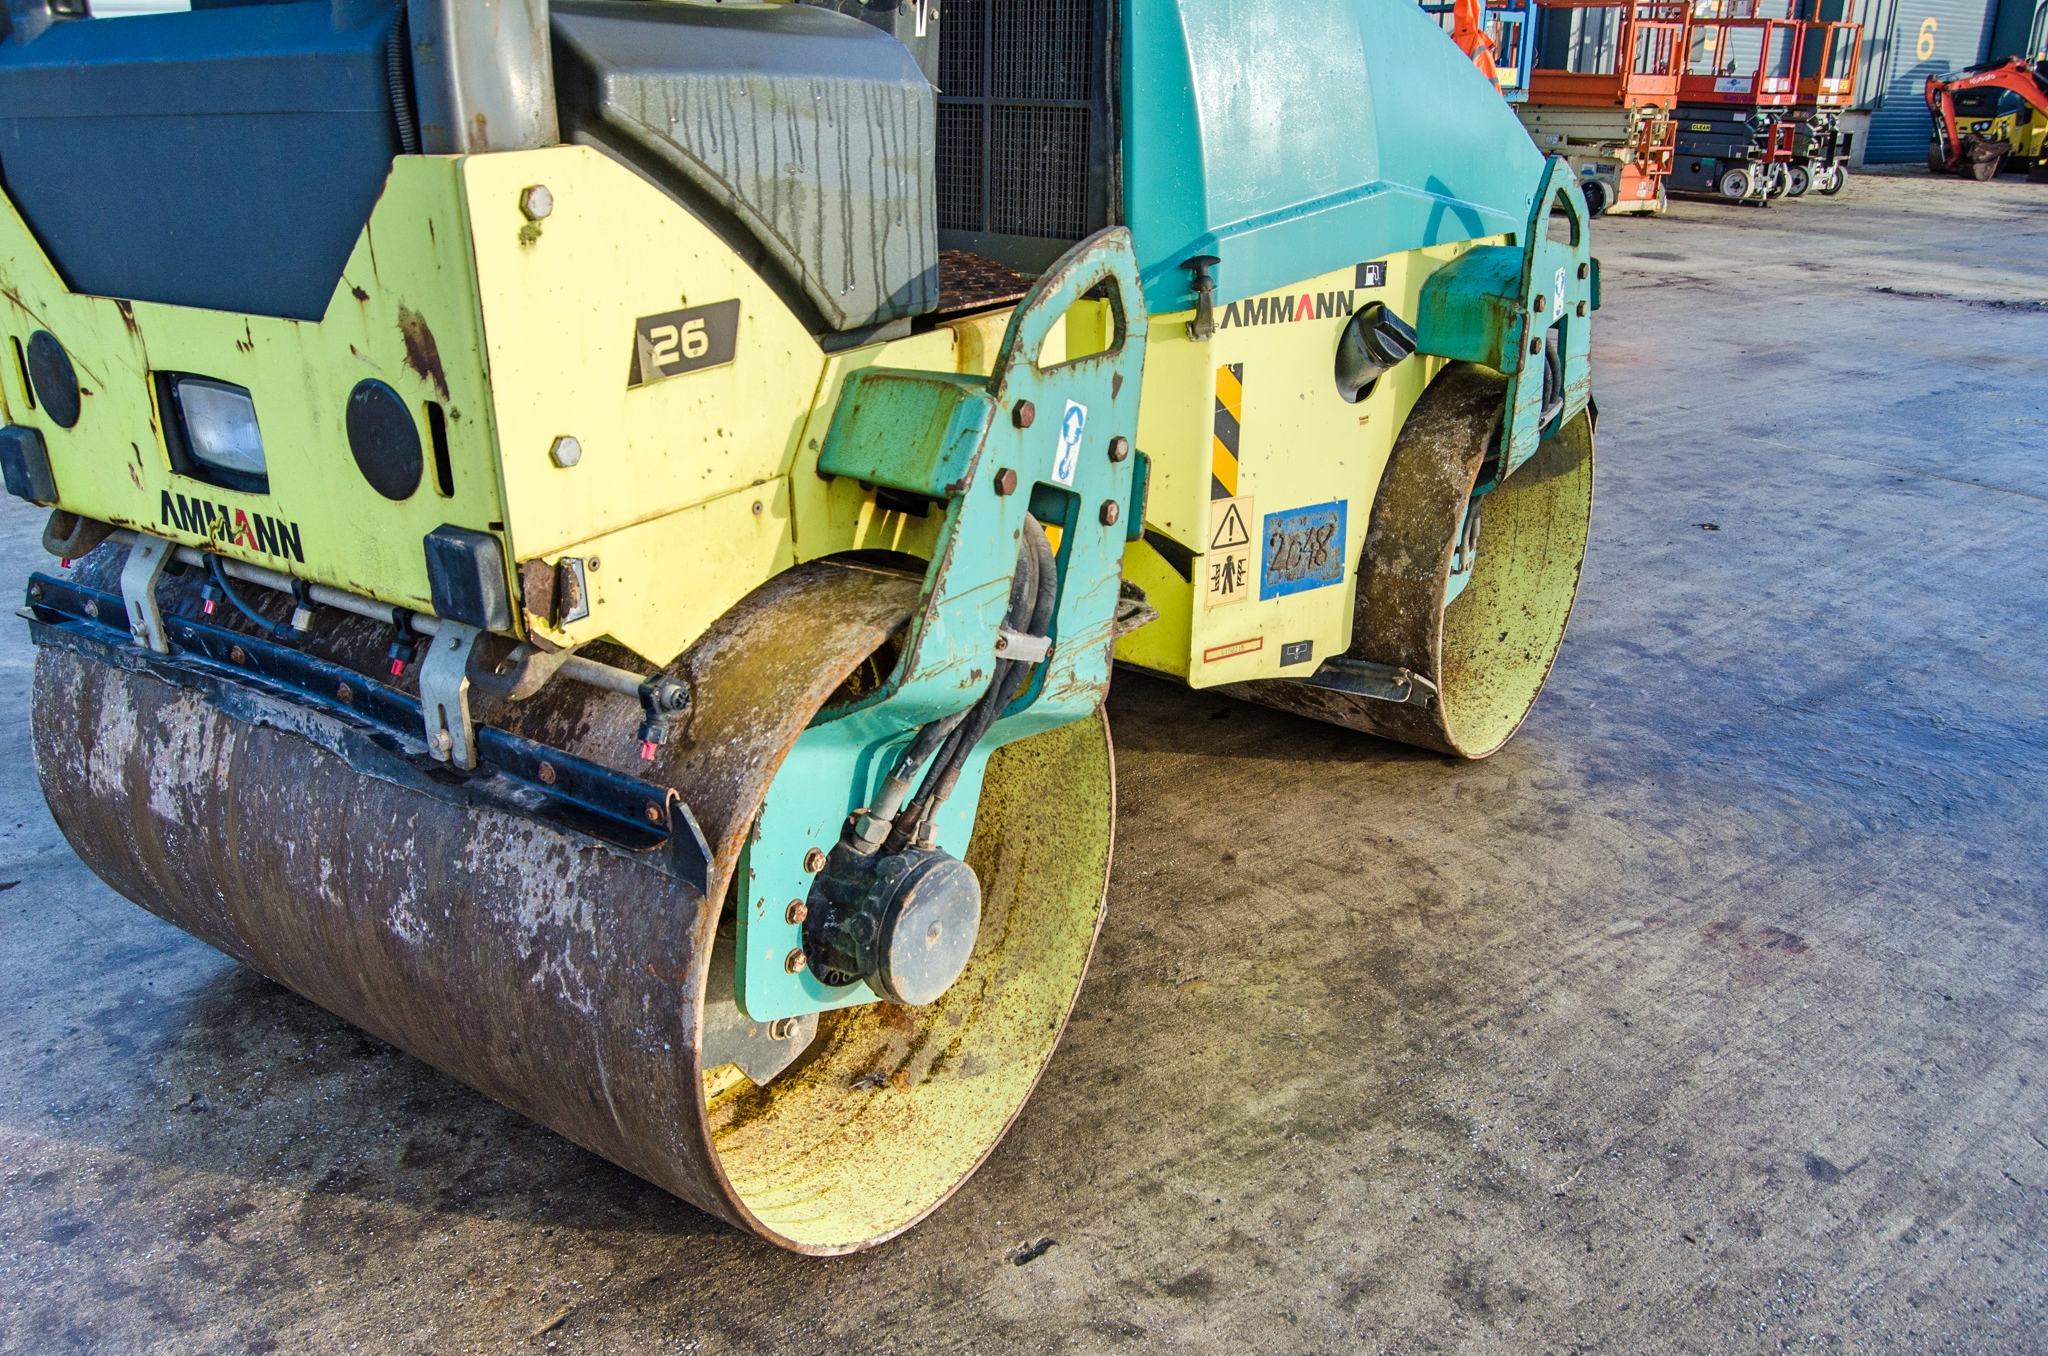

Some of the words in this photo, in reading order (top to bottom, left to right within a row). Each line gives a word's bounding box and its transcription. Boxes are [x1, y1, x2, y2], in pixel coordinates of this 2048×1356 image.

[1916, 17, 1938, 61] 6
[1220, 290, 1355, 330] AMMANN
[649, 317, 709, 367] 26
[161, 489, 305, 564] AMMANN
[1269, 522, 1335, 572] 2048
